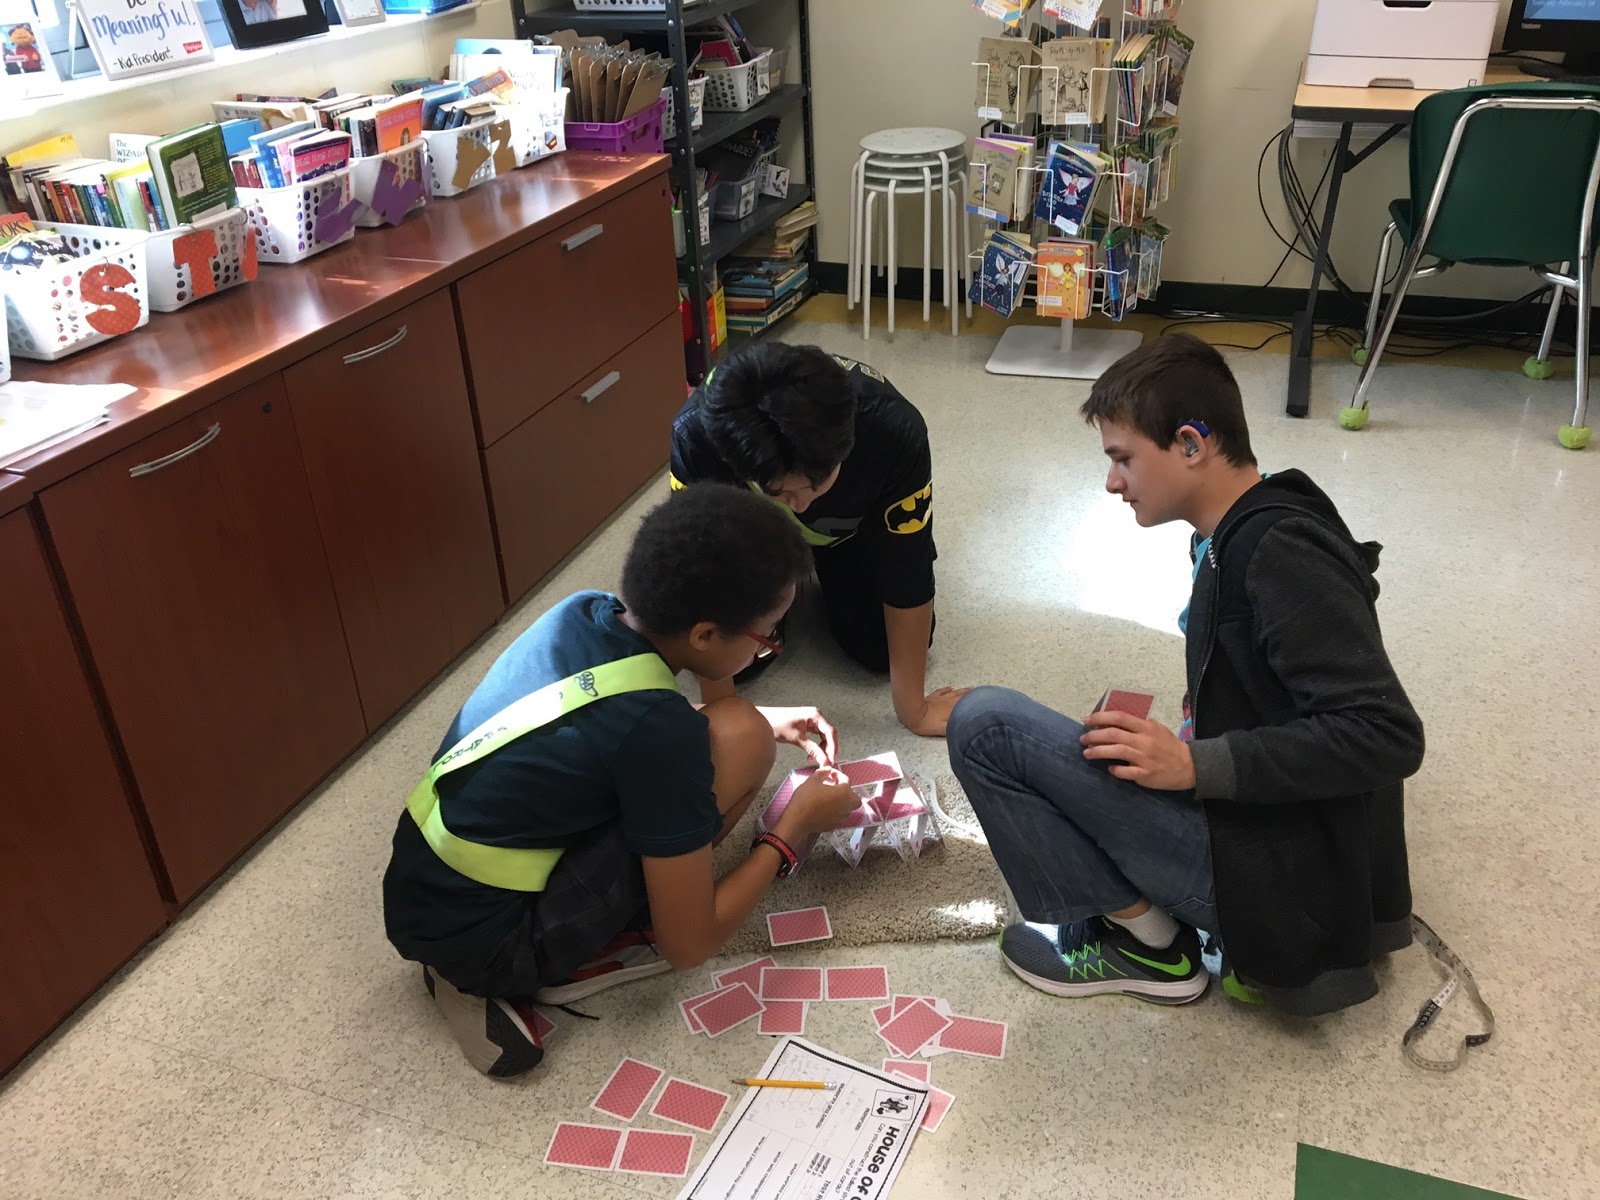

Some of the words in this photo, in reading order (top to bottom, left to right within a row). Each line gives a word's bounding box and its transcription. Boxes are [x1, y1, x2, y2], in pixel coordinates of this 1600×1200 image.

[134, 46, 174, 66] President
[173, 229, 218, 297] T
[80, 263, 141, 335] S
[876, 1122, 885, 1134] Can
[869, 1132, 879, 1143] you
[857, 1142, 874, 1167] construct
[853, 1166, 862, 1177] the
[845, 1176, 857, 1192] tallest
